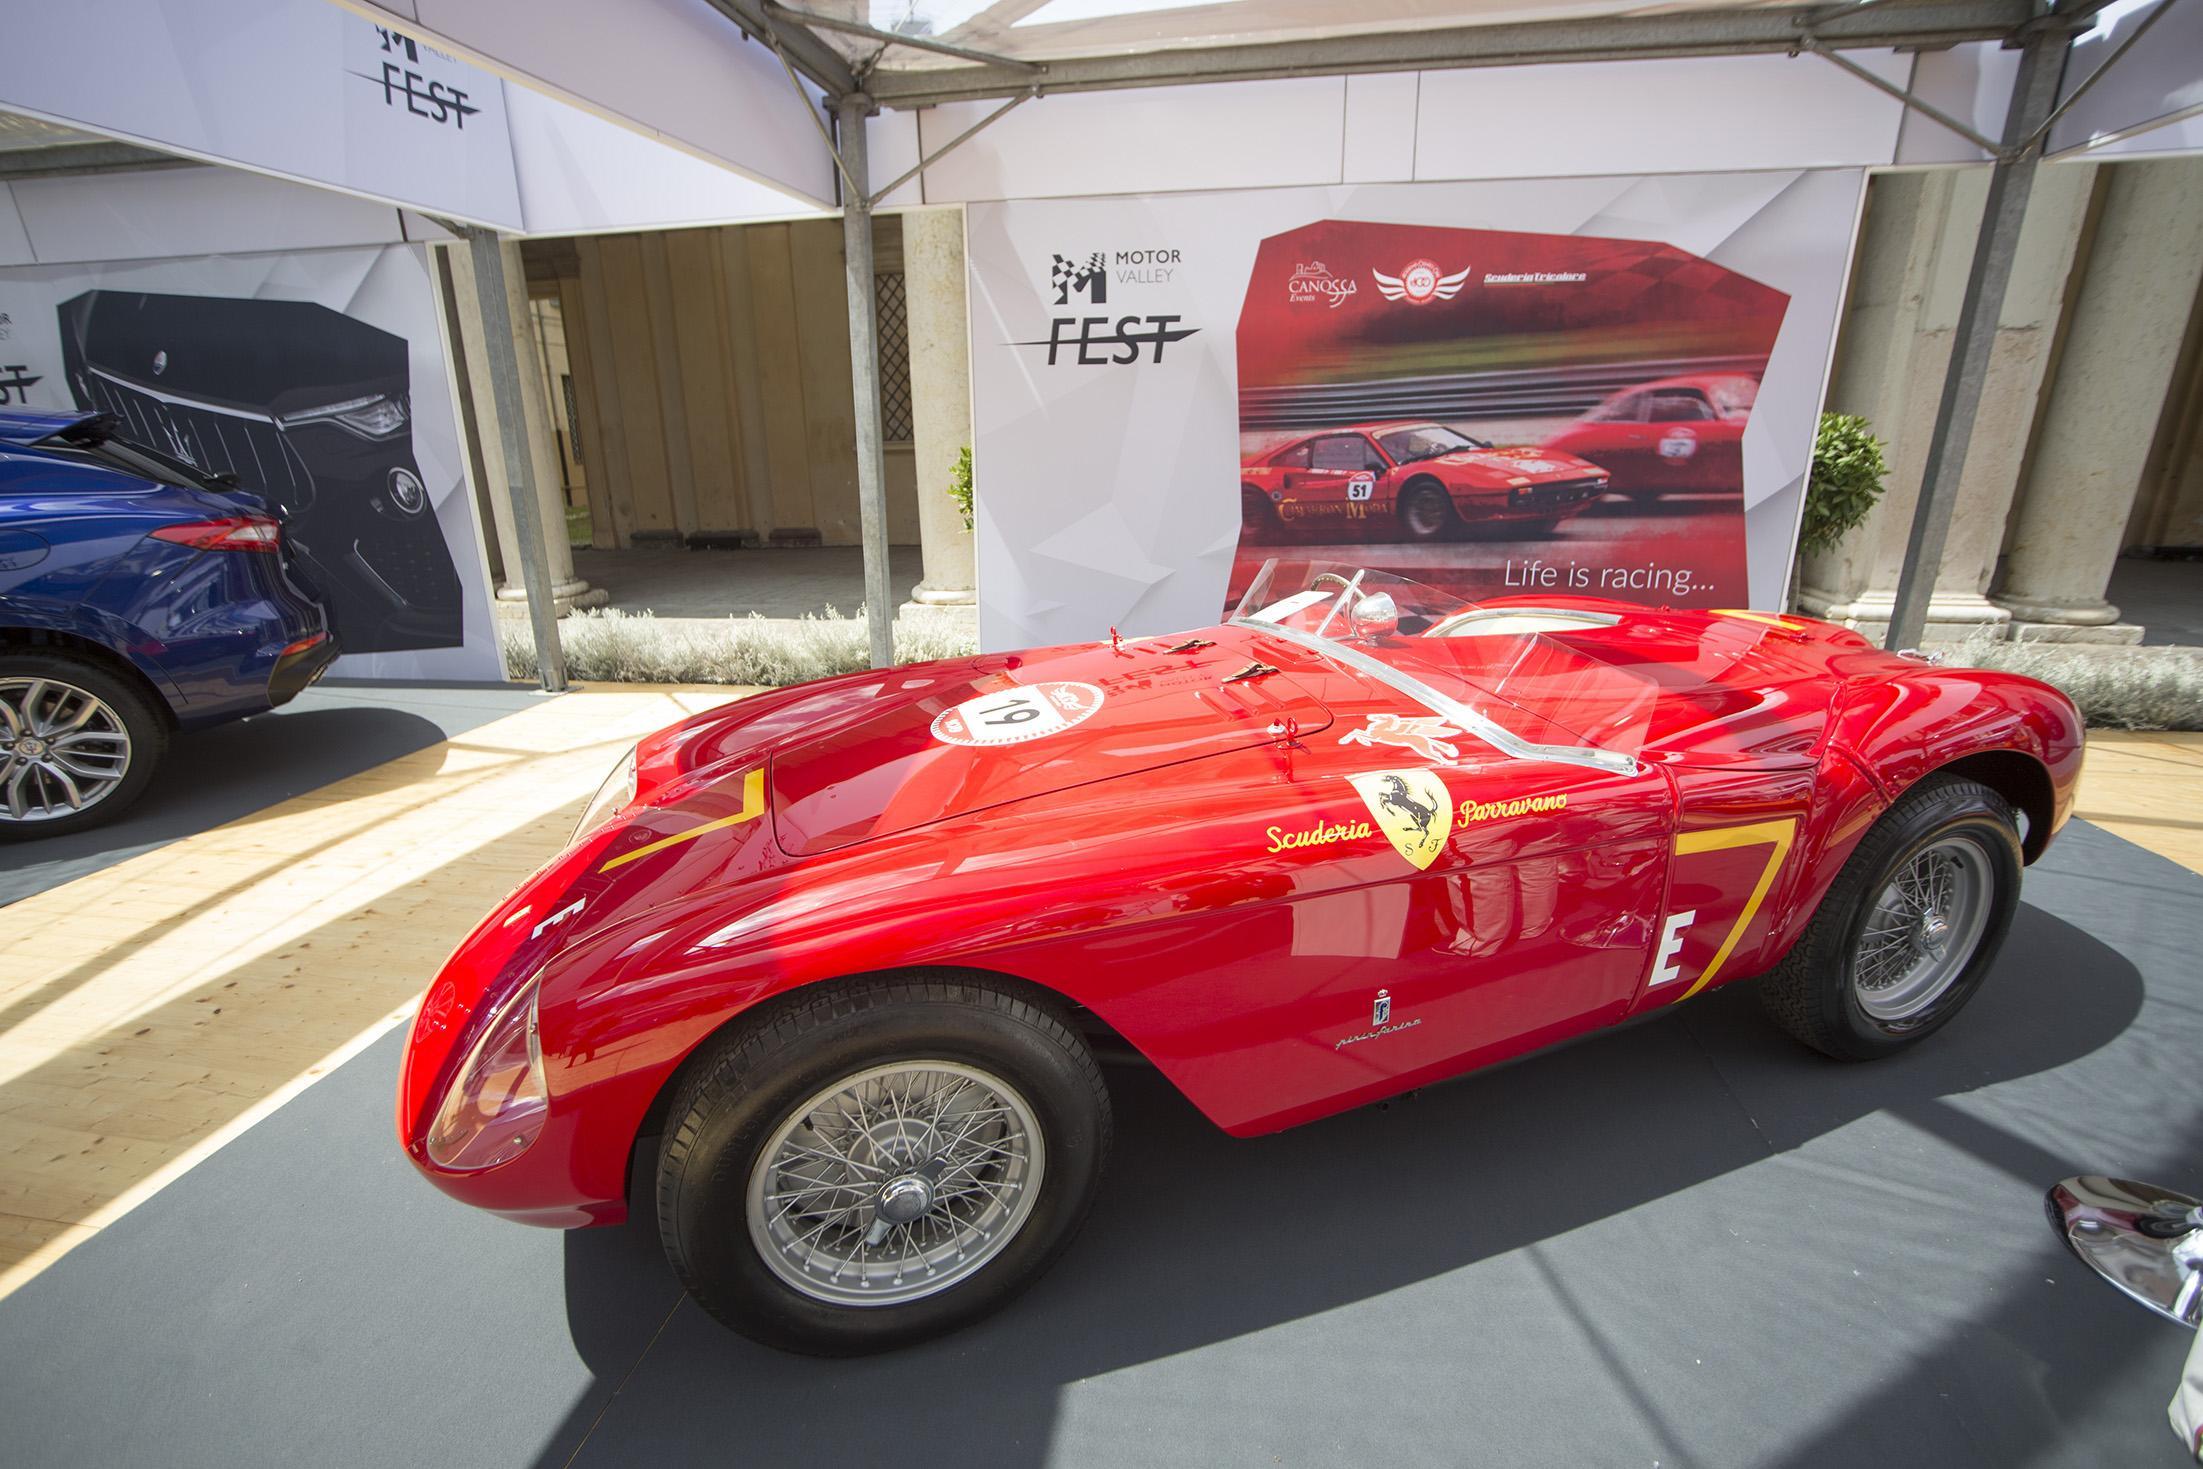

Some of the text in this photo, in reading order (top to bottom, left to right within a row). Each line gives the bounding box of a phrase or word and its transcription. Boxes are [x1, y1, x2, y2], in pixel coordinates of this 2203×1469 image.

[382, 61, 470, 130] FEST
[1115, 249, 1182, 265] MOTOR
[1115, 268, 1175, 284] VALLEY
[1288, 279, 1358, 307] CANOSSA
[1046, 314, 1184, 366] FEST
[1352, 484, 1367, 498] 51
[1504, 558, 1715, 596] Life is racing...
[1266, 793, 1568, 854] Scuderia Parravano
[1671, 817, 1798, 1005] 7
[1648, 909, 1697, 987] E
